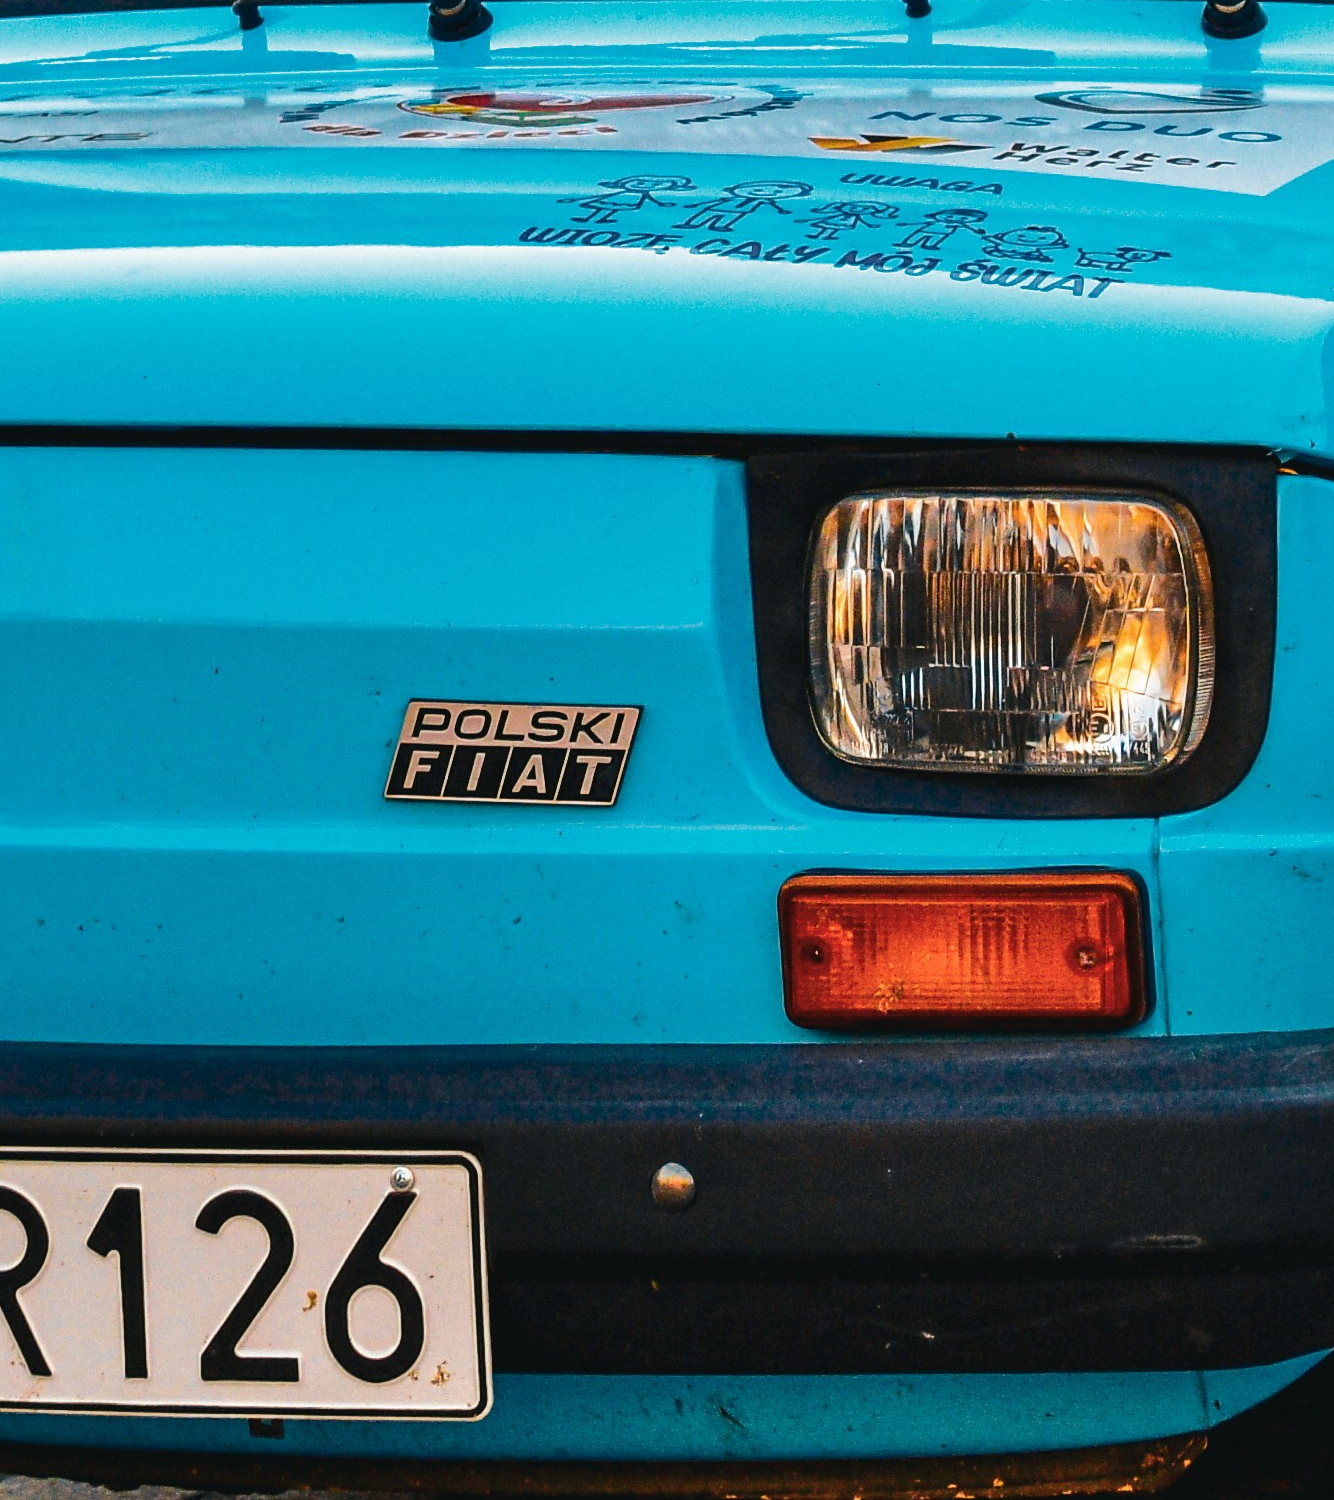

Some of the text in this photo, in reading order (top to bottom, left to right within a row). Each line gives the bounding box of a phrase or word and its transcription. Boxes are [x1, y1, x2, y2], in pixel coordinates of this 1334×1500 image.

[869, 110, 1284, 143] NOS DUO
[993, 150, 1154, 173] Herz
[1008, 142, 1237, 169] Walter
[839, 171, 1005, 195] UWAGA
[689, 237, 832, 264] CAŁY
[835, 246, 942, 277] MÓJ
[949, 257, 1125, 299] ŚWIAT
[411, 707, 626, 745] POLSKI
[403, 750, 613, 796] FIAT
